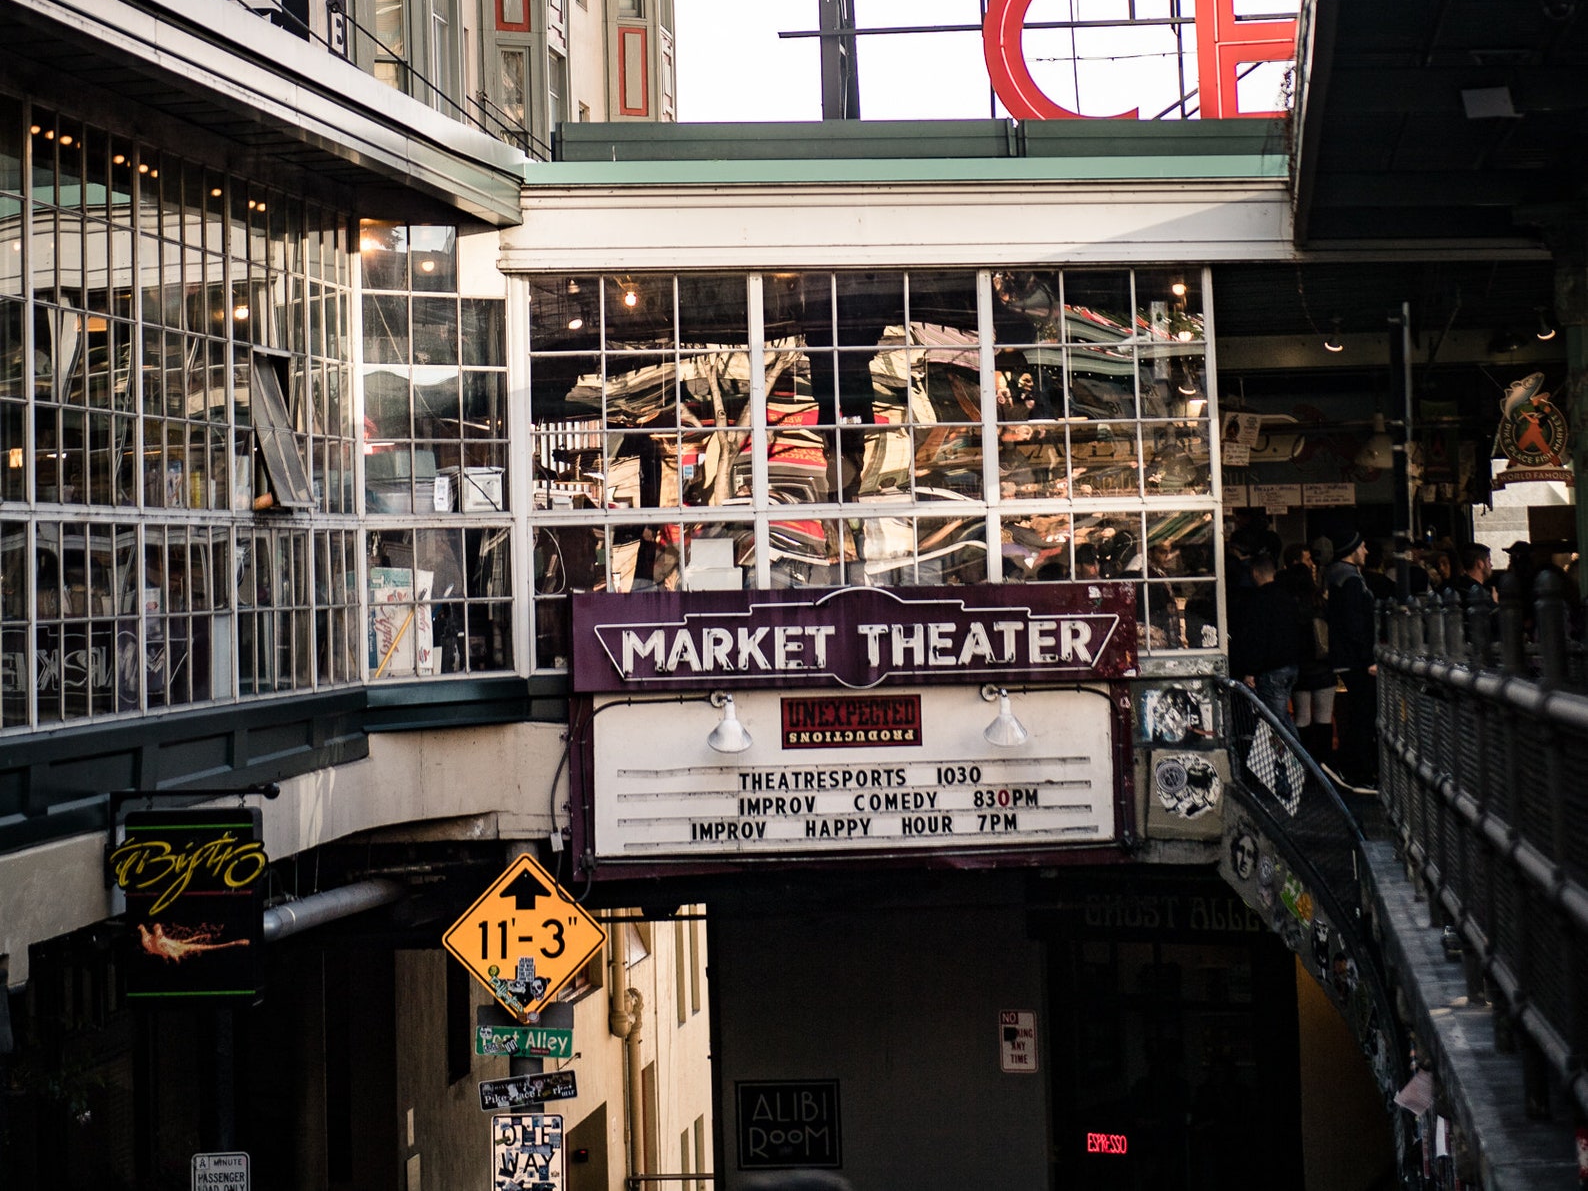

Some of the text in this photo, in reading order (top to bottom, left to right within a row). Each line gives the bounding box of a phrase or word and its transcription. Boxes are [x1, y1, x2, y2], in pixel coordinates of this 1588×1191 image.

[1508, 446, 1534, 464] PLACE
[1551, 414, 1565, 452] MARKET
[1500, 471, 1573, 482] WORLD FAMOUS
[621, 620, 1094, 673] MARKET THEATER
[787, 698, 917, 728] UNEXPECTED
[788, 729, 915, 743] PRODUCTIONS
[739, 765, 982, 791] THEATRESPORTS 1030
[739, 788, 1039, 816] IMPROV COMEDY 830PM
[691, 812, 1018, 841] IMPROV HAPPY HOUR 7PM
[1188, 894, 1265, 932] ALLE
[1002, 1012, 1016, 1024] NO
[525, 1031, 568, 1055] Alley
[1012, 1042, 1026, 1051] ANY
[1010, 1054, 1028, 1064] TIME
[751, 1090, 828, 1122] ALIBI
[1087, 1132, 1128, 1155] ESPRESSO
[213, 1158, 243, 1167] MINUTE
[501, 1152, 556, 1173] WAY
[197, 1171, 246, 1184] PASSENGER
